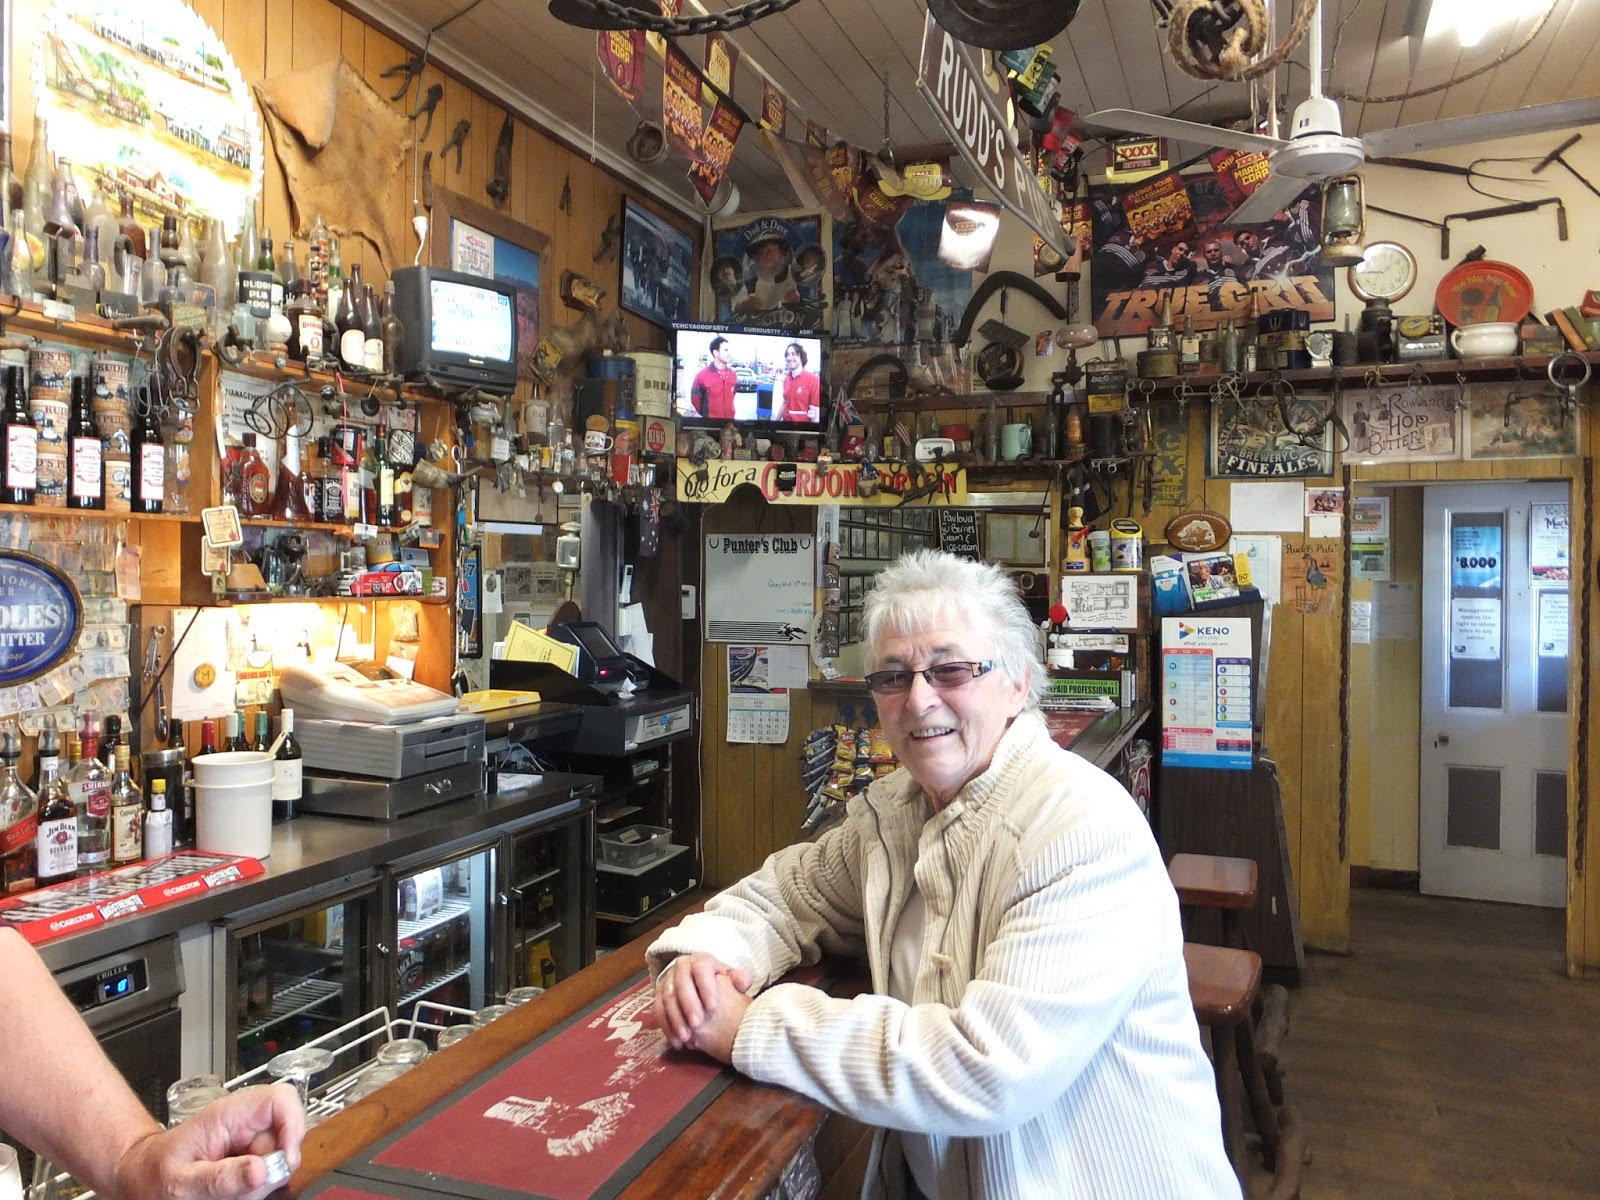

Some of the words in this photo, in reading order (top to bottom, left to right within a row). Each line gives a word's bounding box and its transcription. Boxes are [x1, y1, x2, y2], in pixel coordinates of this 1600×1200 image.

[611, 38, 630, 63] CORP
[1216, 156, 1235, 174] JOIN
[1242, 168, 1269, 186] CORP
[1127, 185, 1152, 201] PLEDGE
[1155, 176, 1174, 189] YOUR
[744, 223, 761, 241] Dad
[761, 220, 770, 229] &
[770, 219, 789, 236] Dave
[249, 290, 268, 299] PUB
[1095, 285, 1210, 324] TRUE
[1218, 275, 1326, 312] GRIT
[643, 380, 671, 391] BREA
[1388, 415, 1429, 435] HOP
[648, 428, 665, 443] KING
[1239, 449, 1288, 463] BREWERY
[1226, 454, 1269, 475] FINE
[1271, 453, 1320, 475] ALES
[712, 465, 743, 491] for
[745, 468, 757, 481] a
[761, 462, 858, 500] GRDON
[943, 510, 974, 524] Pavlova
[951, 524, 976, 534] Berries
[722, 537, 769, 554] Punter's
[772, 537, 798, 554] Club
[943, 534, 964, 542] Cream
[946, 543, 978, 552] ice-cream
[1197, 626, 1230, 636] KENO
[1051, 684, 1068, 695] PAID
[1068, 685, 1115, 695] PROFESSIONAL
[81, 780, 112, 793] SMIRNO
[6, 831, 20, 843] Red
[46, 825, 58, 838] JIM
[60, 822, 76, 832] BEAM
[170, 880, 201, 895] CARLTON
[60, 912, 95, 929] CARLTON
[96, 964, 128, 981] CHILLER
